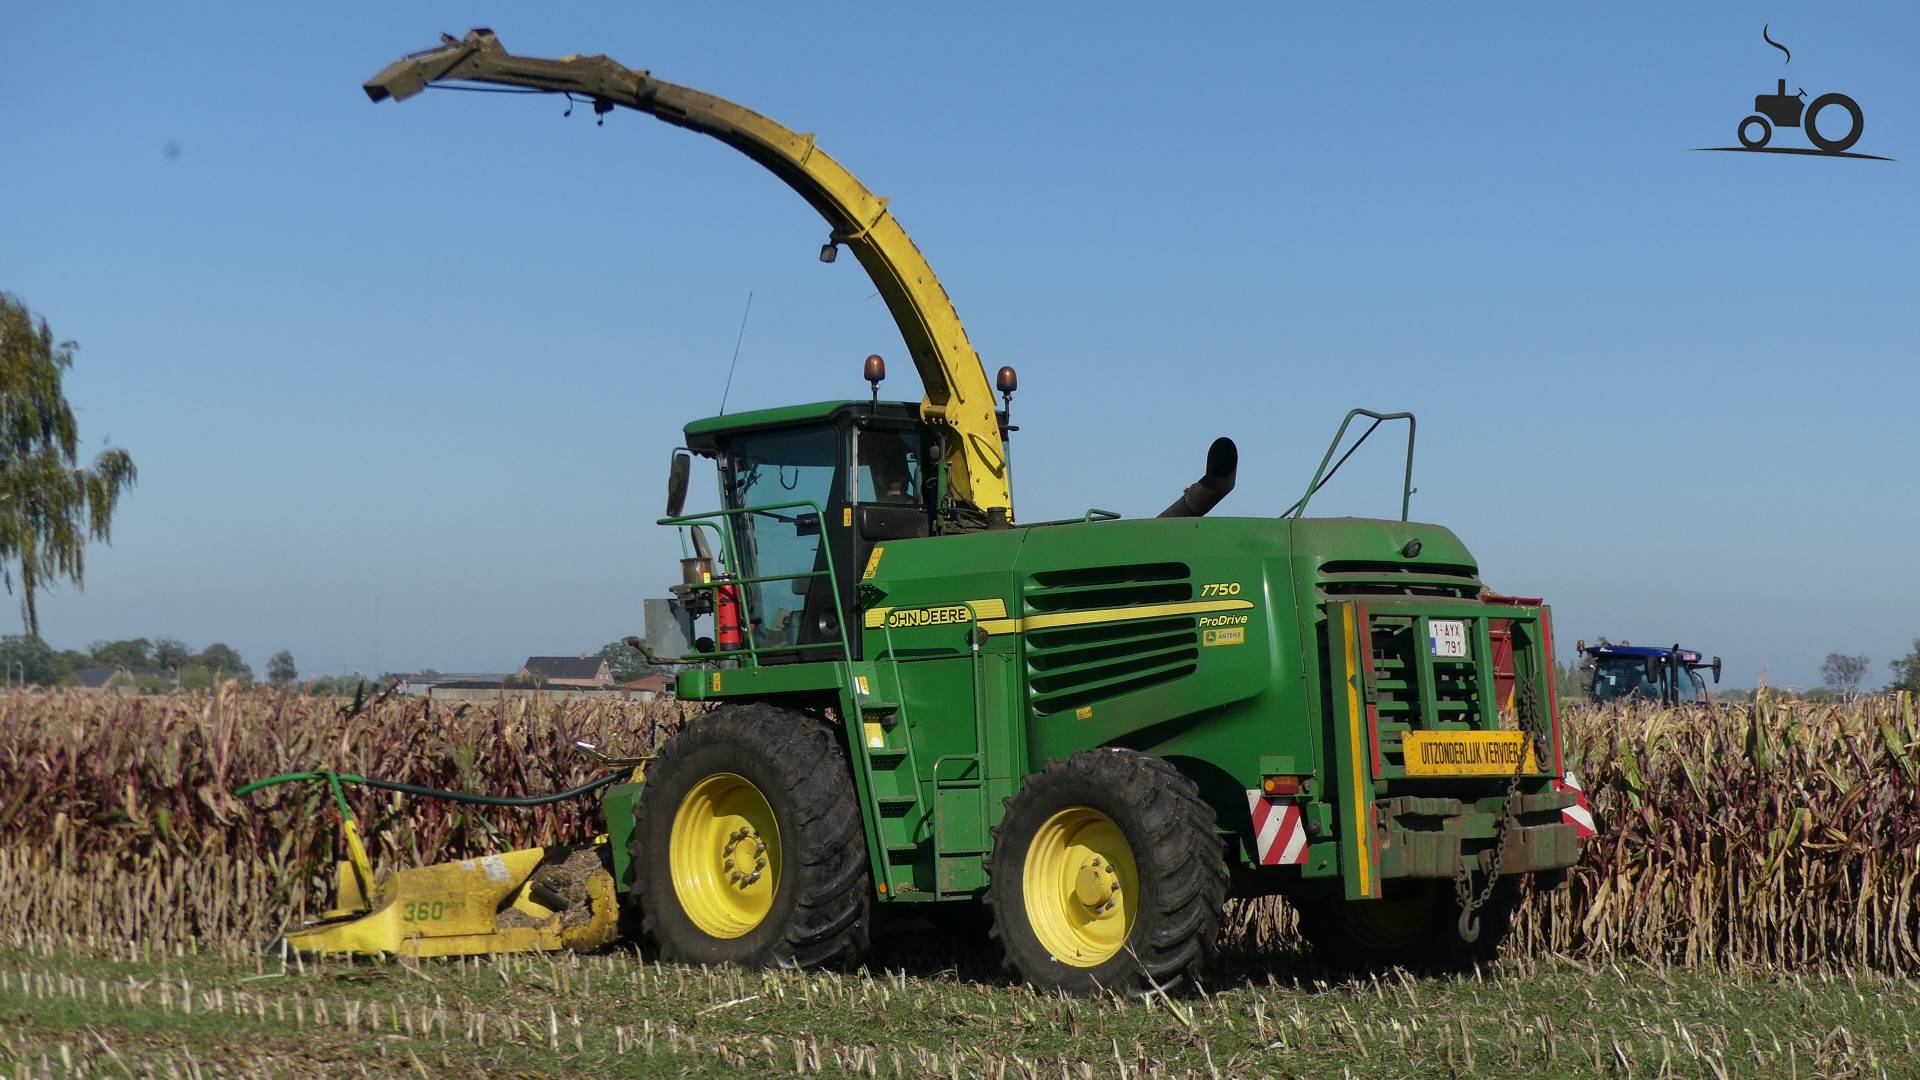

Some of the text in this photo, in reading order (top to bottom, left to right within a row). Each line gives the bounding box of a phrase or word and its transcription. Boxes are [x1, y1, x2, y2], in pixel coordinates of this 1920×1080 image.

[1200, 582, 1241, 597] 7750
[919, 608, 966, 624] DEERE
[1198, 614, 1248, 628] ProDrive
[1445, 640, 1462, 654] 791
[1420, 741, 1520, 765] UITZONDERLIJK VERVOER
[403, 901, 444, 922] 360
